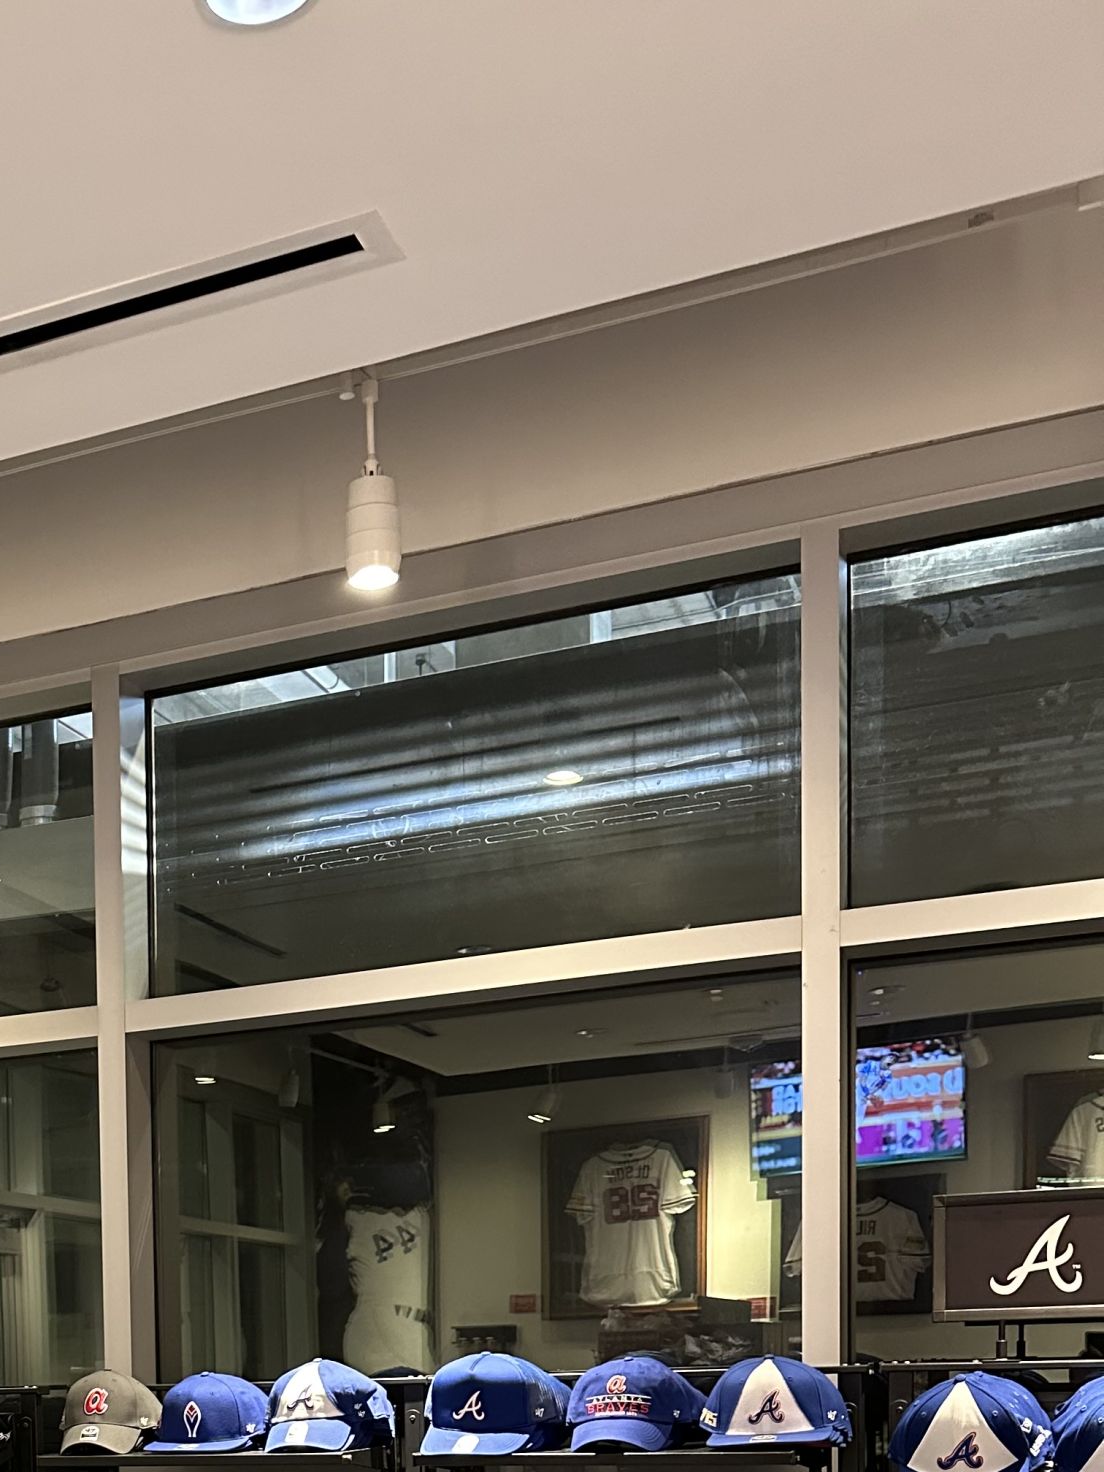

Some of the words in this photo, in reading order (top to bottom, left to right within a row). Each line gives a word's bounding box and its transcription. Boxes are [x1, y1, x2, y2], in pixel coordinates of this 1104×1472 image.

[989, 1214, 1083, 1295] A
[452, 1390, 485, 1420] A
[587, 1401, 650, 1414] BRAVES
[748, 1390, 785, 1425] A
[936, 1431, 984, 1470] A
